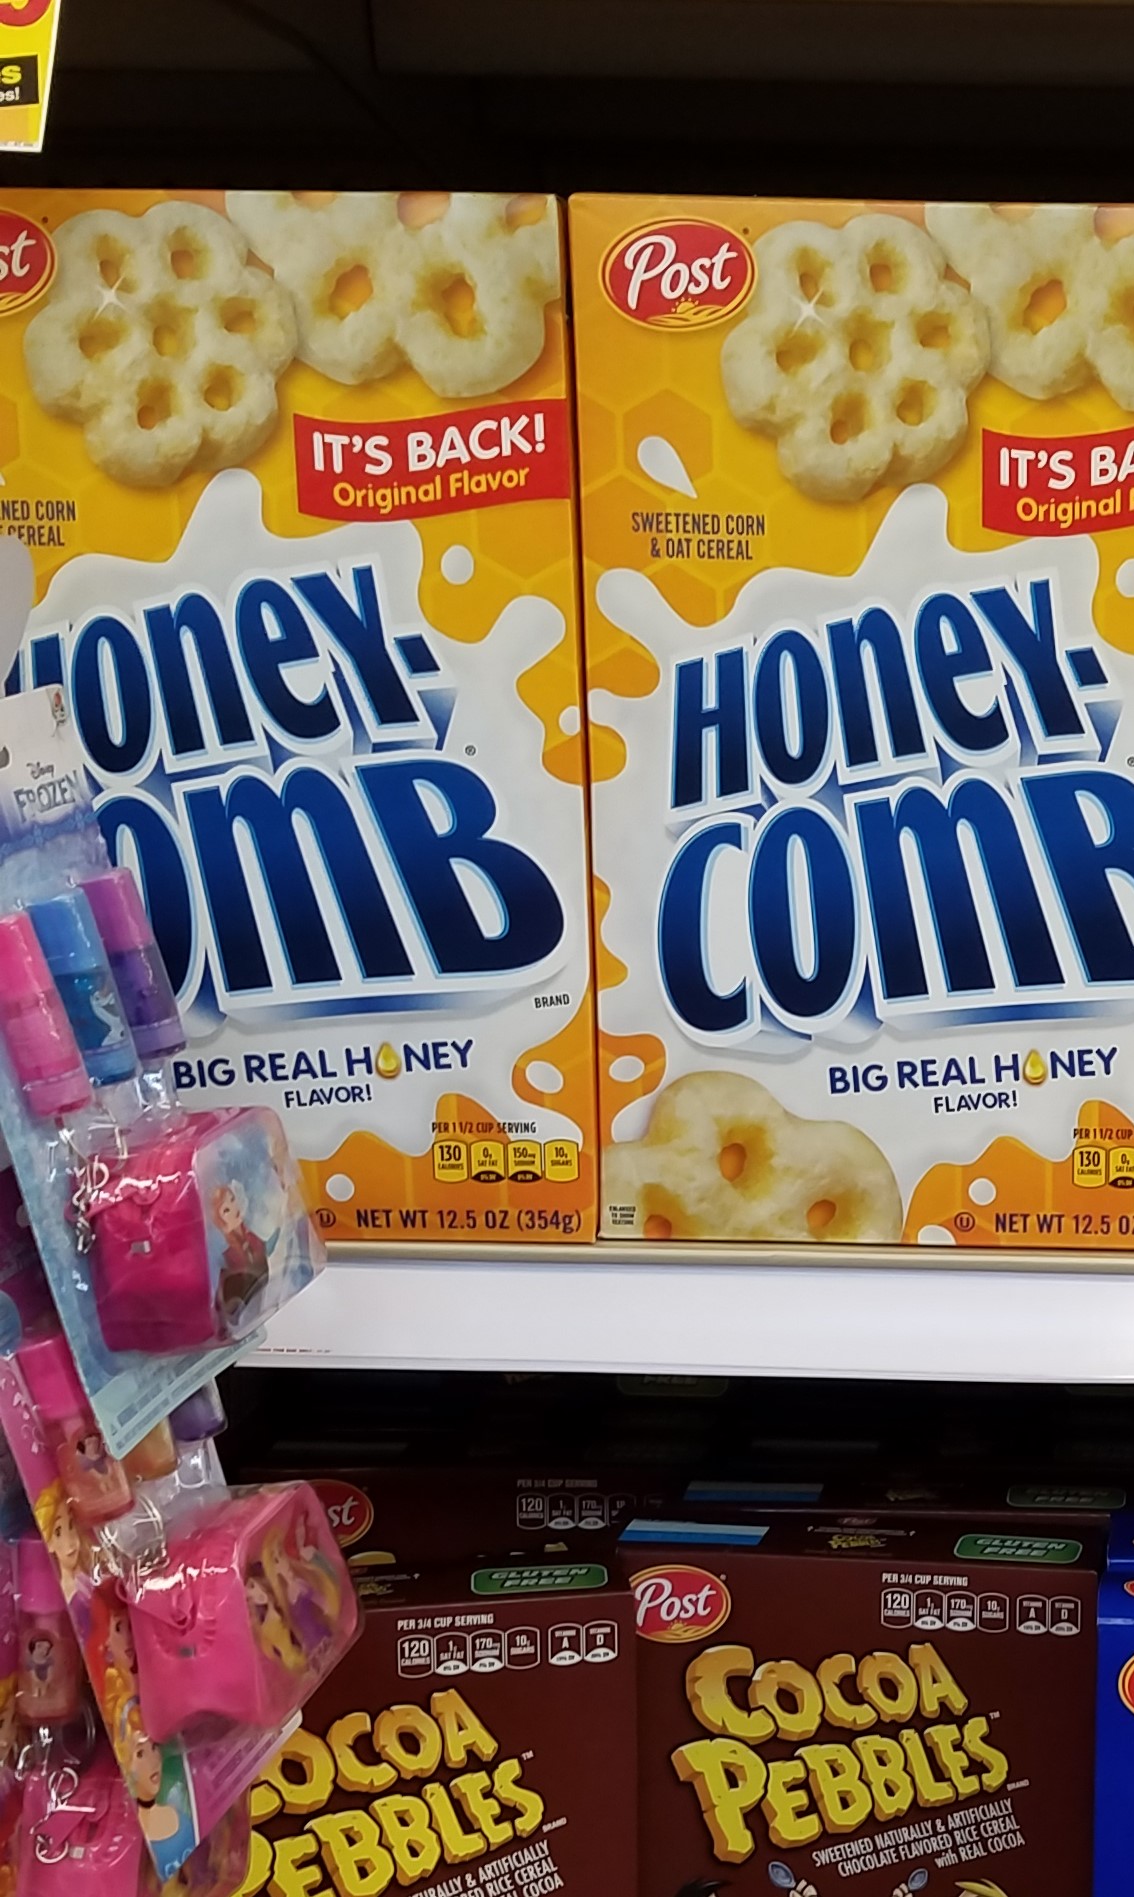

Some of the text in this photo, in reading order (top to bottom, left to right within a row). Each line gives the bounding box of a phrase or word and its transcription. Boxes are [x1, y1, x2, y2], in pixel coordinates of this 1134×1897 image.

[621, 234, 738, 309] Post
[313, 413, 547, 475] IT'S BACK!
[999, 447, 1077, 490] IT'S
[333, 467, 530, 515] Original Flavor
[35, 500, 76, 521] CORN
[1015, 495, 1123, 529] Original
[632, 511, 766, 537] SWEETENED CORN
[650, 537, 753, 561] & OAT CEREAL
[534, 993, 570, 1009] BRAND
[173, 1059, 236, 1089] BIG
[244, 1049, 337, 1083] REAL
[829, 1063, 888, 1096] BIG
[898, 1055, 986, 1089] REAL
[284, 1084, 373, 1109] FLAVOR!
[933, 1089, 1018, 1115] FLAVOR!
[432, 1122, 450, 1133] PER
[476, 1122, 494, 1133] CUP
[497, 1122, 536, 1133] SERVING
[1073, 1128, 1091, 1139] PER
[1116, 1129, 1133, 1140] CUP
[439, 1145, 461, 1161] 130
[1079, 1151, 1100, 1167] 130
[357, 1209, 582, 1234] NET WT 12.5 OZ (354g)
[995, 1213, 1030, 1233] NET
[1036, 1214, 1065, 1234] WT
[1072, 1215, 1110, 1235] 12.5
[882, 1573, 968, 1586] PER 3/4 CUP SERVING
[635, 1577, 712, 1628] Post
[885, 1593, 909, 1609] 120
[397, 1613, 493, 1631] PER 3/4 CUP SERVING
[402, 1640, 429, 1657] 120
[686, 1643, 968, 1745] COCOA
[670, 1717, 1009, 1864] PEBBLES
[812, 1798, 1014, 1867] SWEETENED NATURALLY & ARTIFICIALLY
[838, 1815, 1020, 1877] CHOCOLATE FLAVORED RICE CEREAL
[934, 1832, 1026, 1869] with REAL COCOA
[465, 1873, 477, 1888] &
[478, 1839, 550, 1883] ARTIFICIALLY
[486, 1873, 511, 1895] RICE
[514, 1857, 558, 1886] CEREAL
[522, 1874, 564, 1897] COCOA
